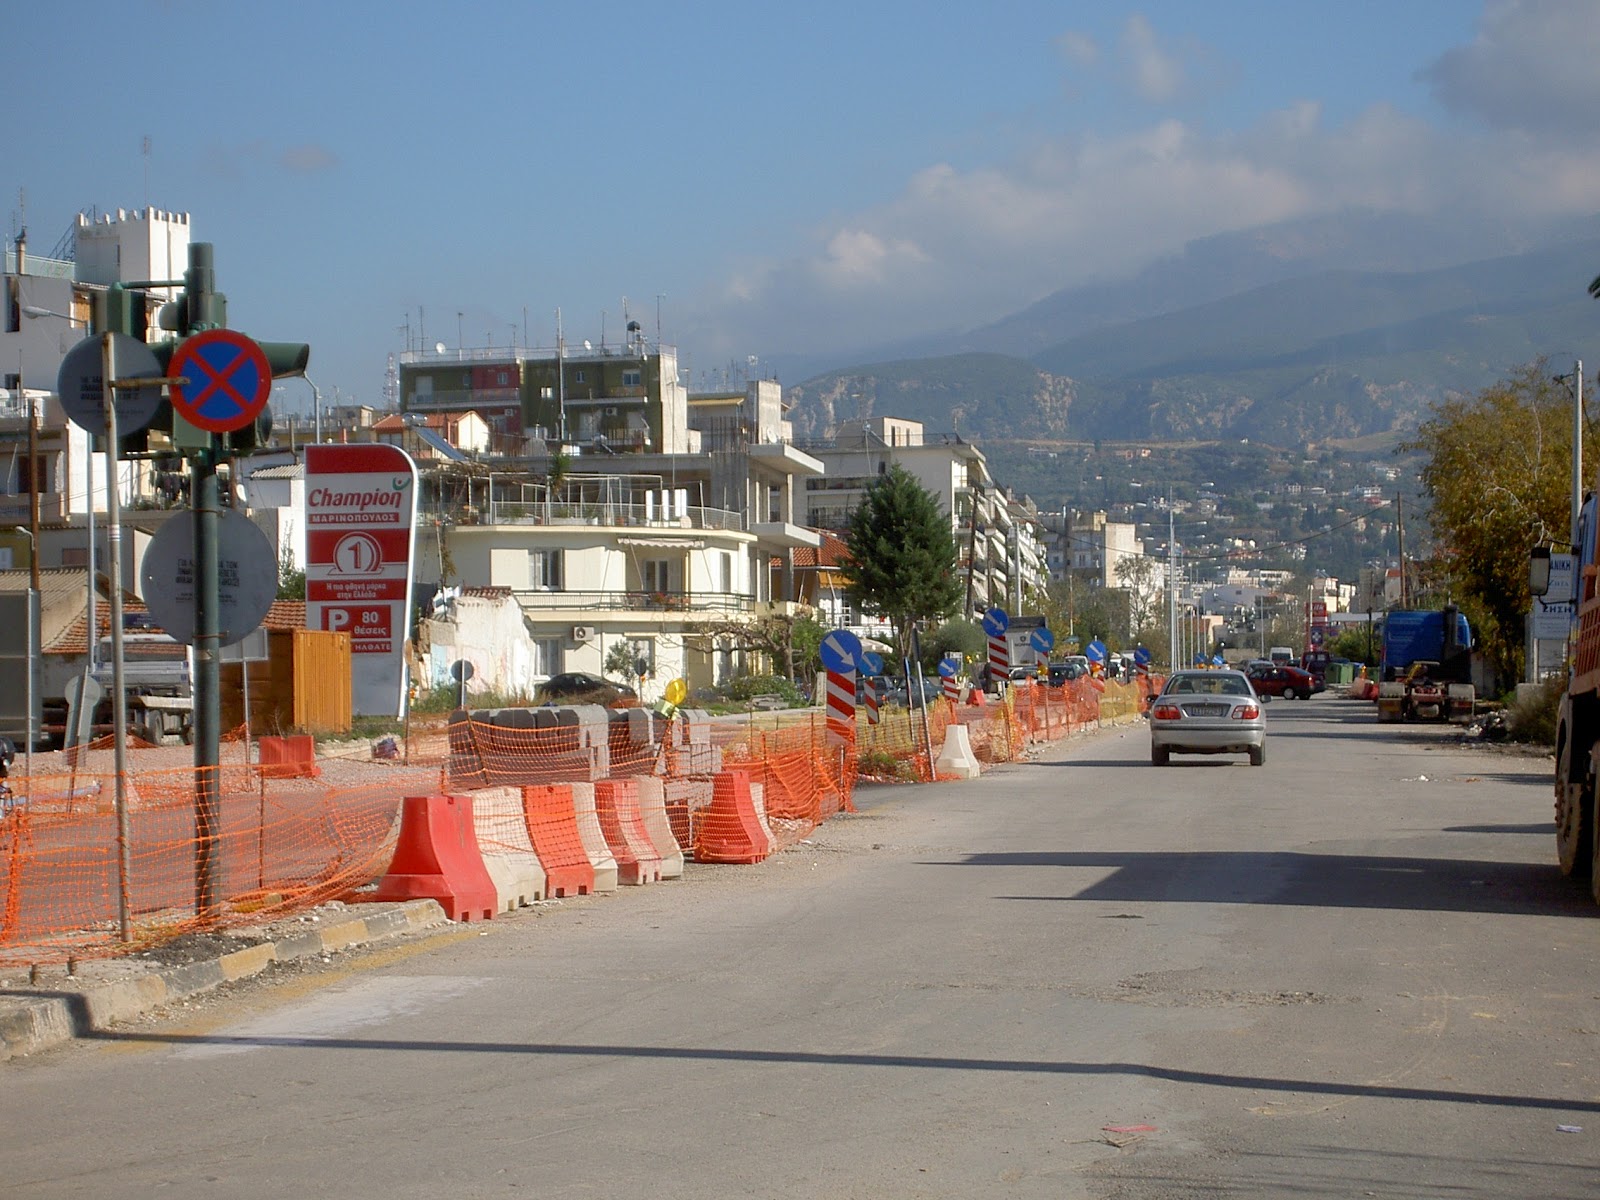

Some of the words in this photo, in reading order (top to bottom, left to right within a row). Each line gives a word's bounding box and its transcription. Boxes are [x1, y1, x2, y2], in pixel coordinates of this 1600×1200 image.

[308, 488, 402, 511] Champion
[312, 514, 395, 522] ΜΑΡΙΝΟΠΟΥΛΟΣ
[348, 541, 361, 569] 1
[328, 608, 350, 632] P
[362, 611, 379, 623] 80
[354, 625, 387, 635] θέσεις
